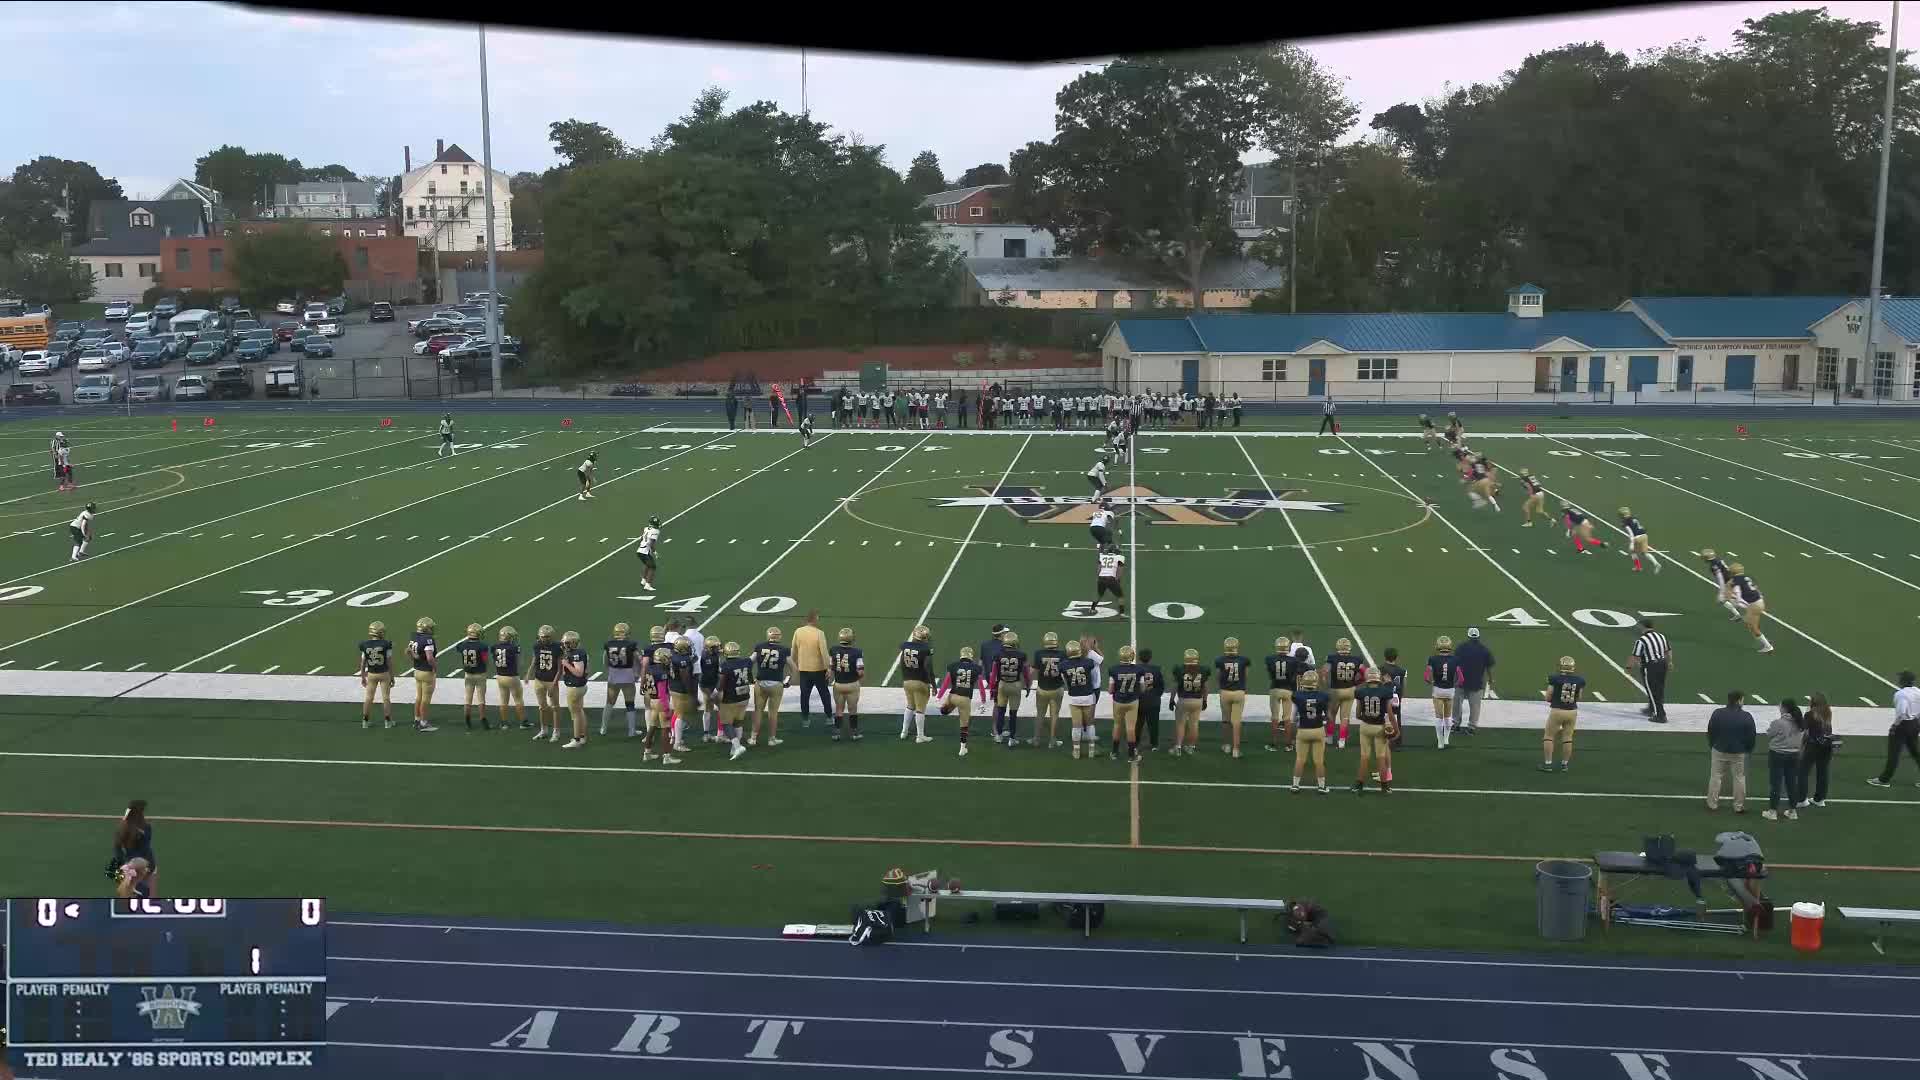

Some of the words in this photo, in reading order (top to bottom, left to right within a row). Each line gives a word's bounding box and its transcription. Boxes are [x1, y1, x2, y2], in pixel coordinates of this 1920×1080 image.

[1102, 557, 1114, 568] 32
[366, 646, 384, 666] 35
[463, 649, 477, 667] 13
[495, 648, 507, 667] 31
[760, 648, 779, 670] 72
[836, 653, 850, 672] 14
[956, 668, 971, 688] 21
[1224, 662, 1239, 681] 71
[1275, 661, 1287, 680] 11
[1118, 673, 1137, 693] 77
[1306, 698, 1317, 719] 5
[1364, 695, 1381, 717] 10
